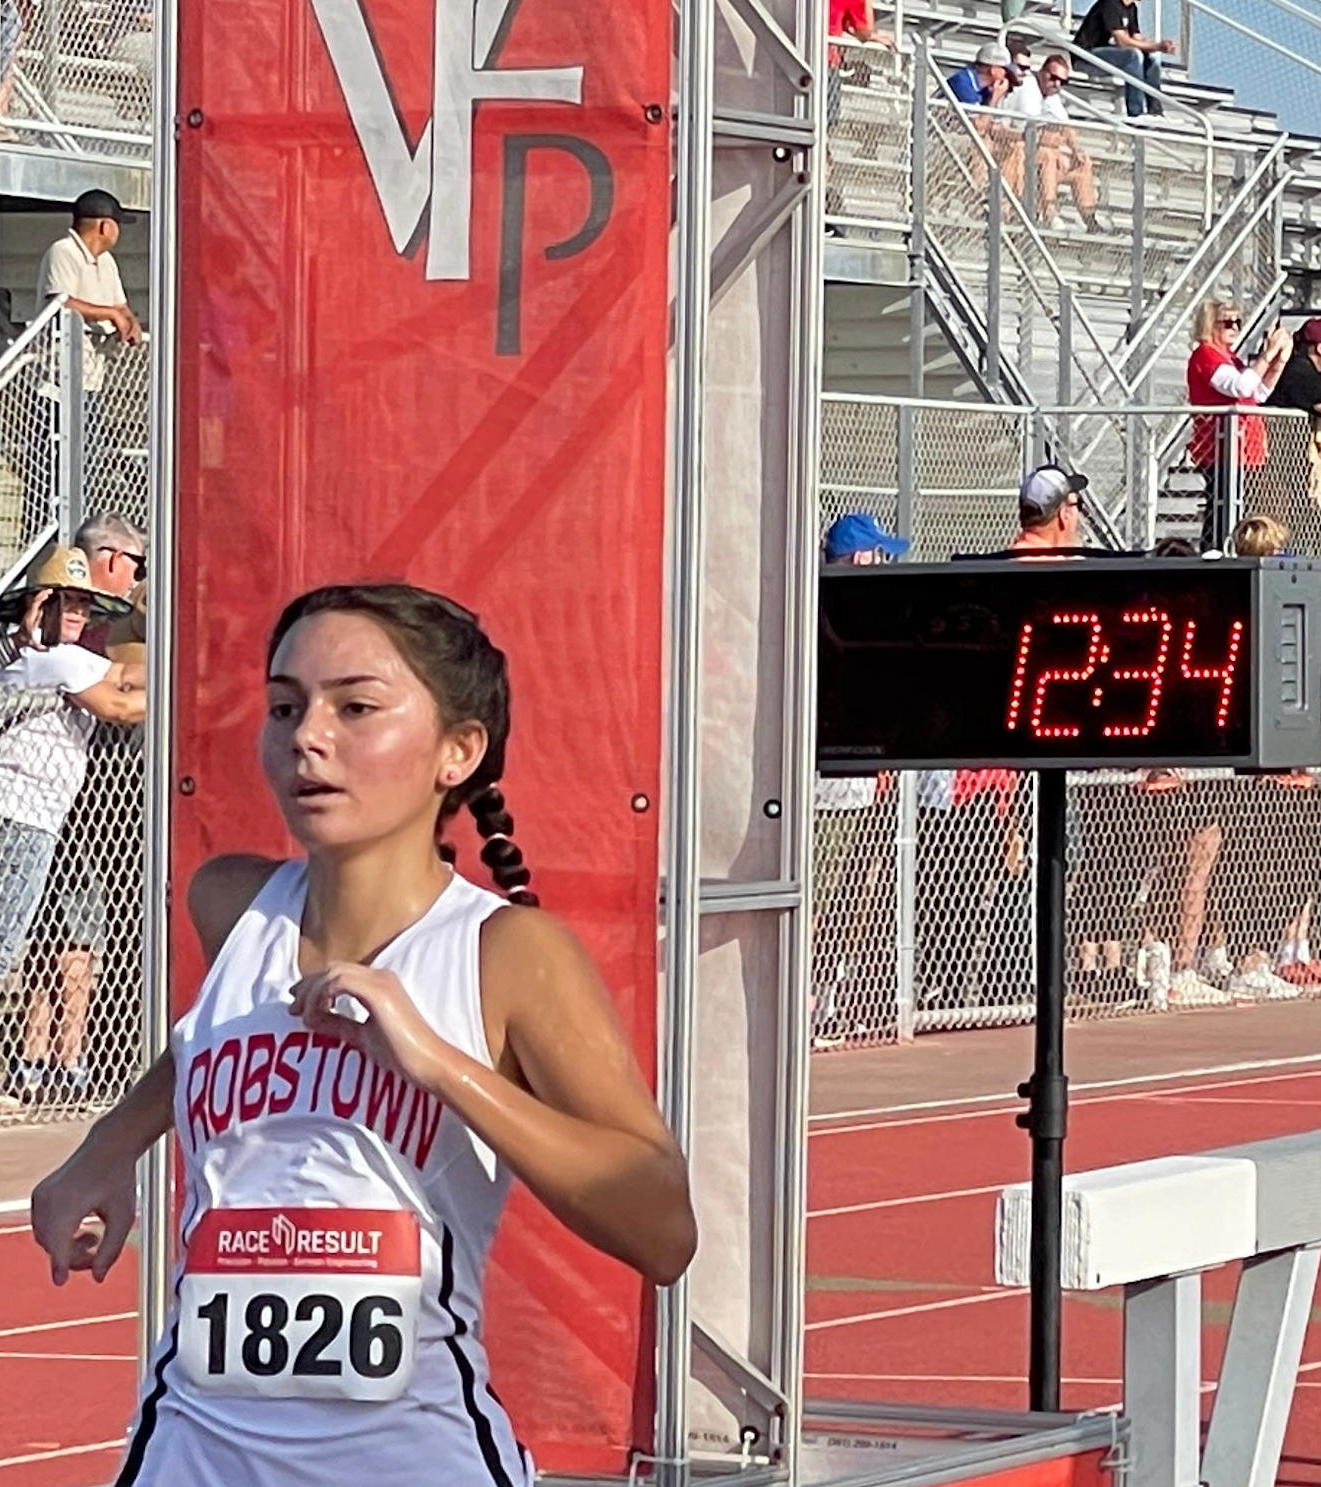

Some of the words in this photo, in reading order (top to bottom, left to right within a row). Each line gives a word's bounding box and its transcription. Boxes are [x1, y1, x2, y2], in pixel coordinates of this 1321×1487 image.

[186, 1030, 443, 1172] ROBSTOWN
[217, 1229, 271, 1254] RACE
[296, 1229, 383, 1255] RESULT
[196, 1292, 404, 1379] 1826
